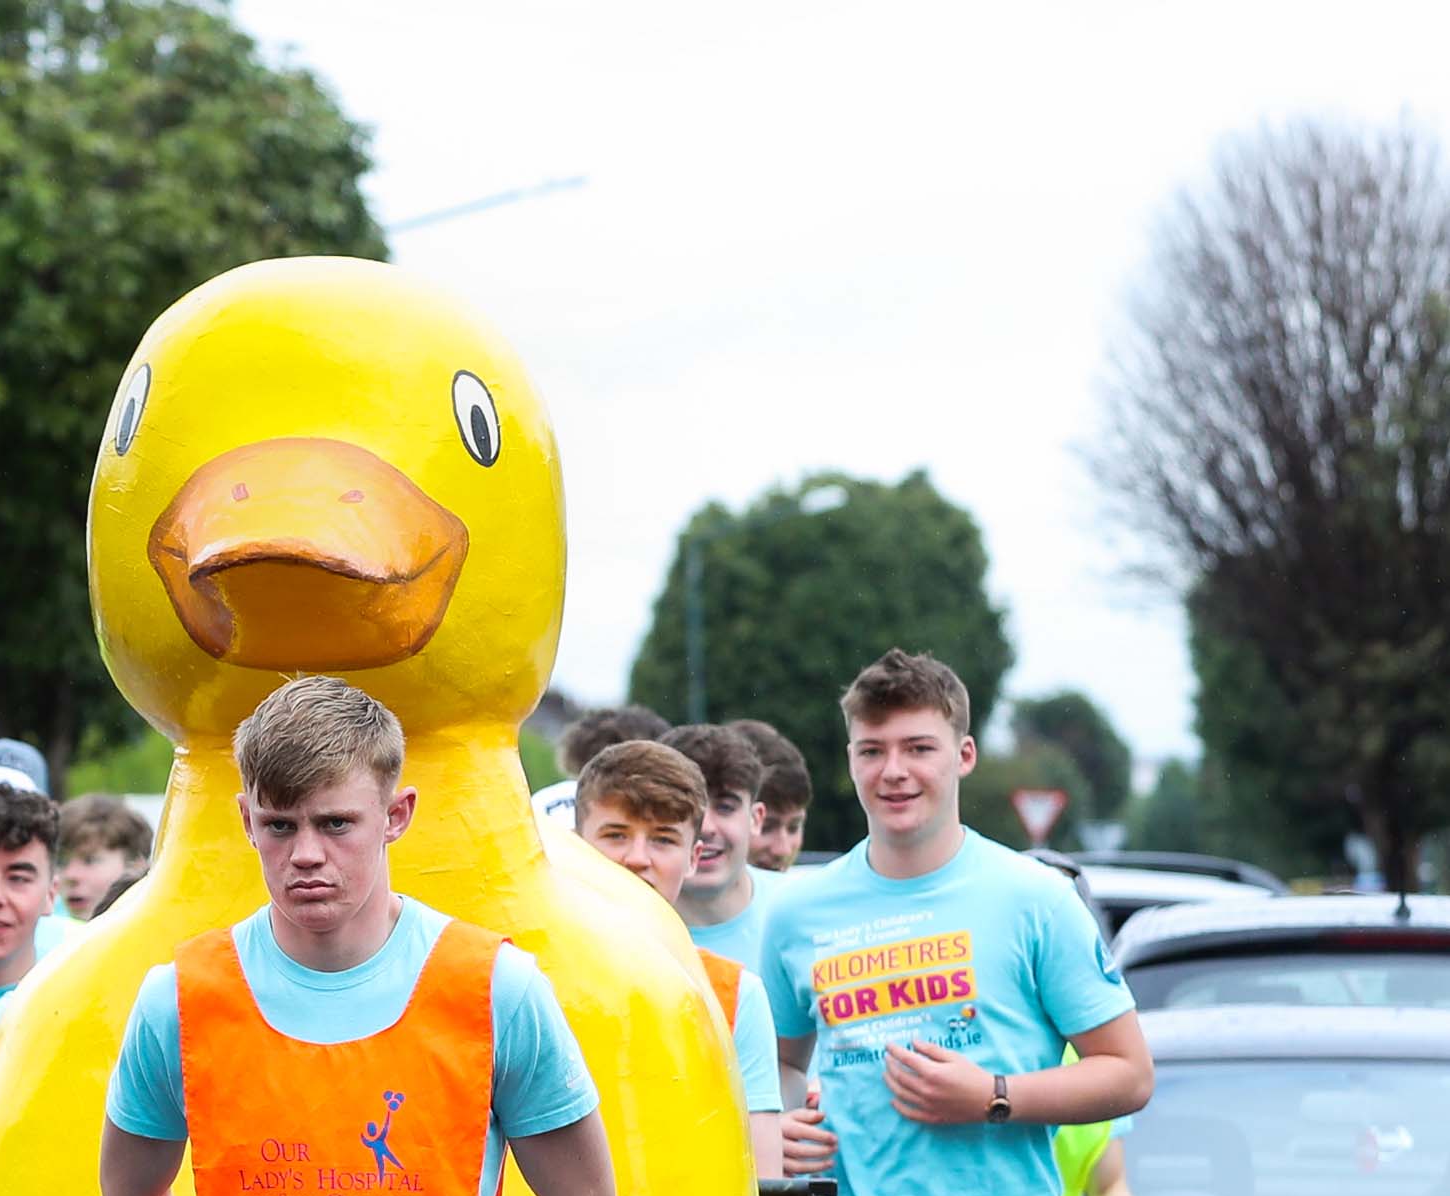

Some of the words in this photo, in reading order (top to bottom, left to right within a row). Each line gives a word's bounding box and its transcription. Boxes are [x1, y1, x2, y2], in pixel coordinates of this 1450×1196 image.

[812, 935, 968, 987] KILOMETRES
[819, 987, 879, 1024] FOR
[888, 970, 972, 1010] KIDS
